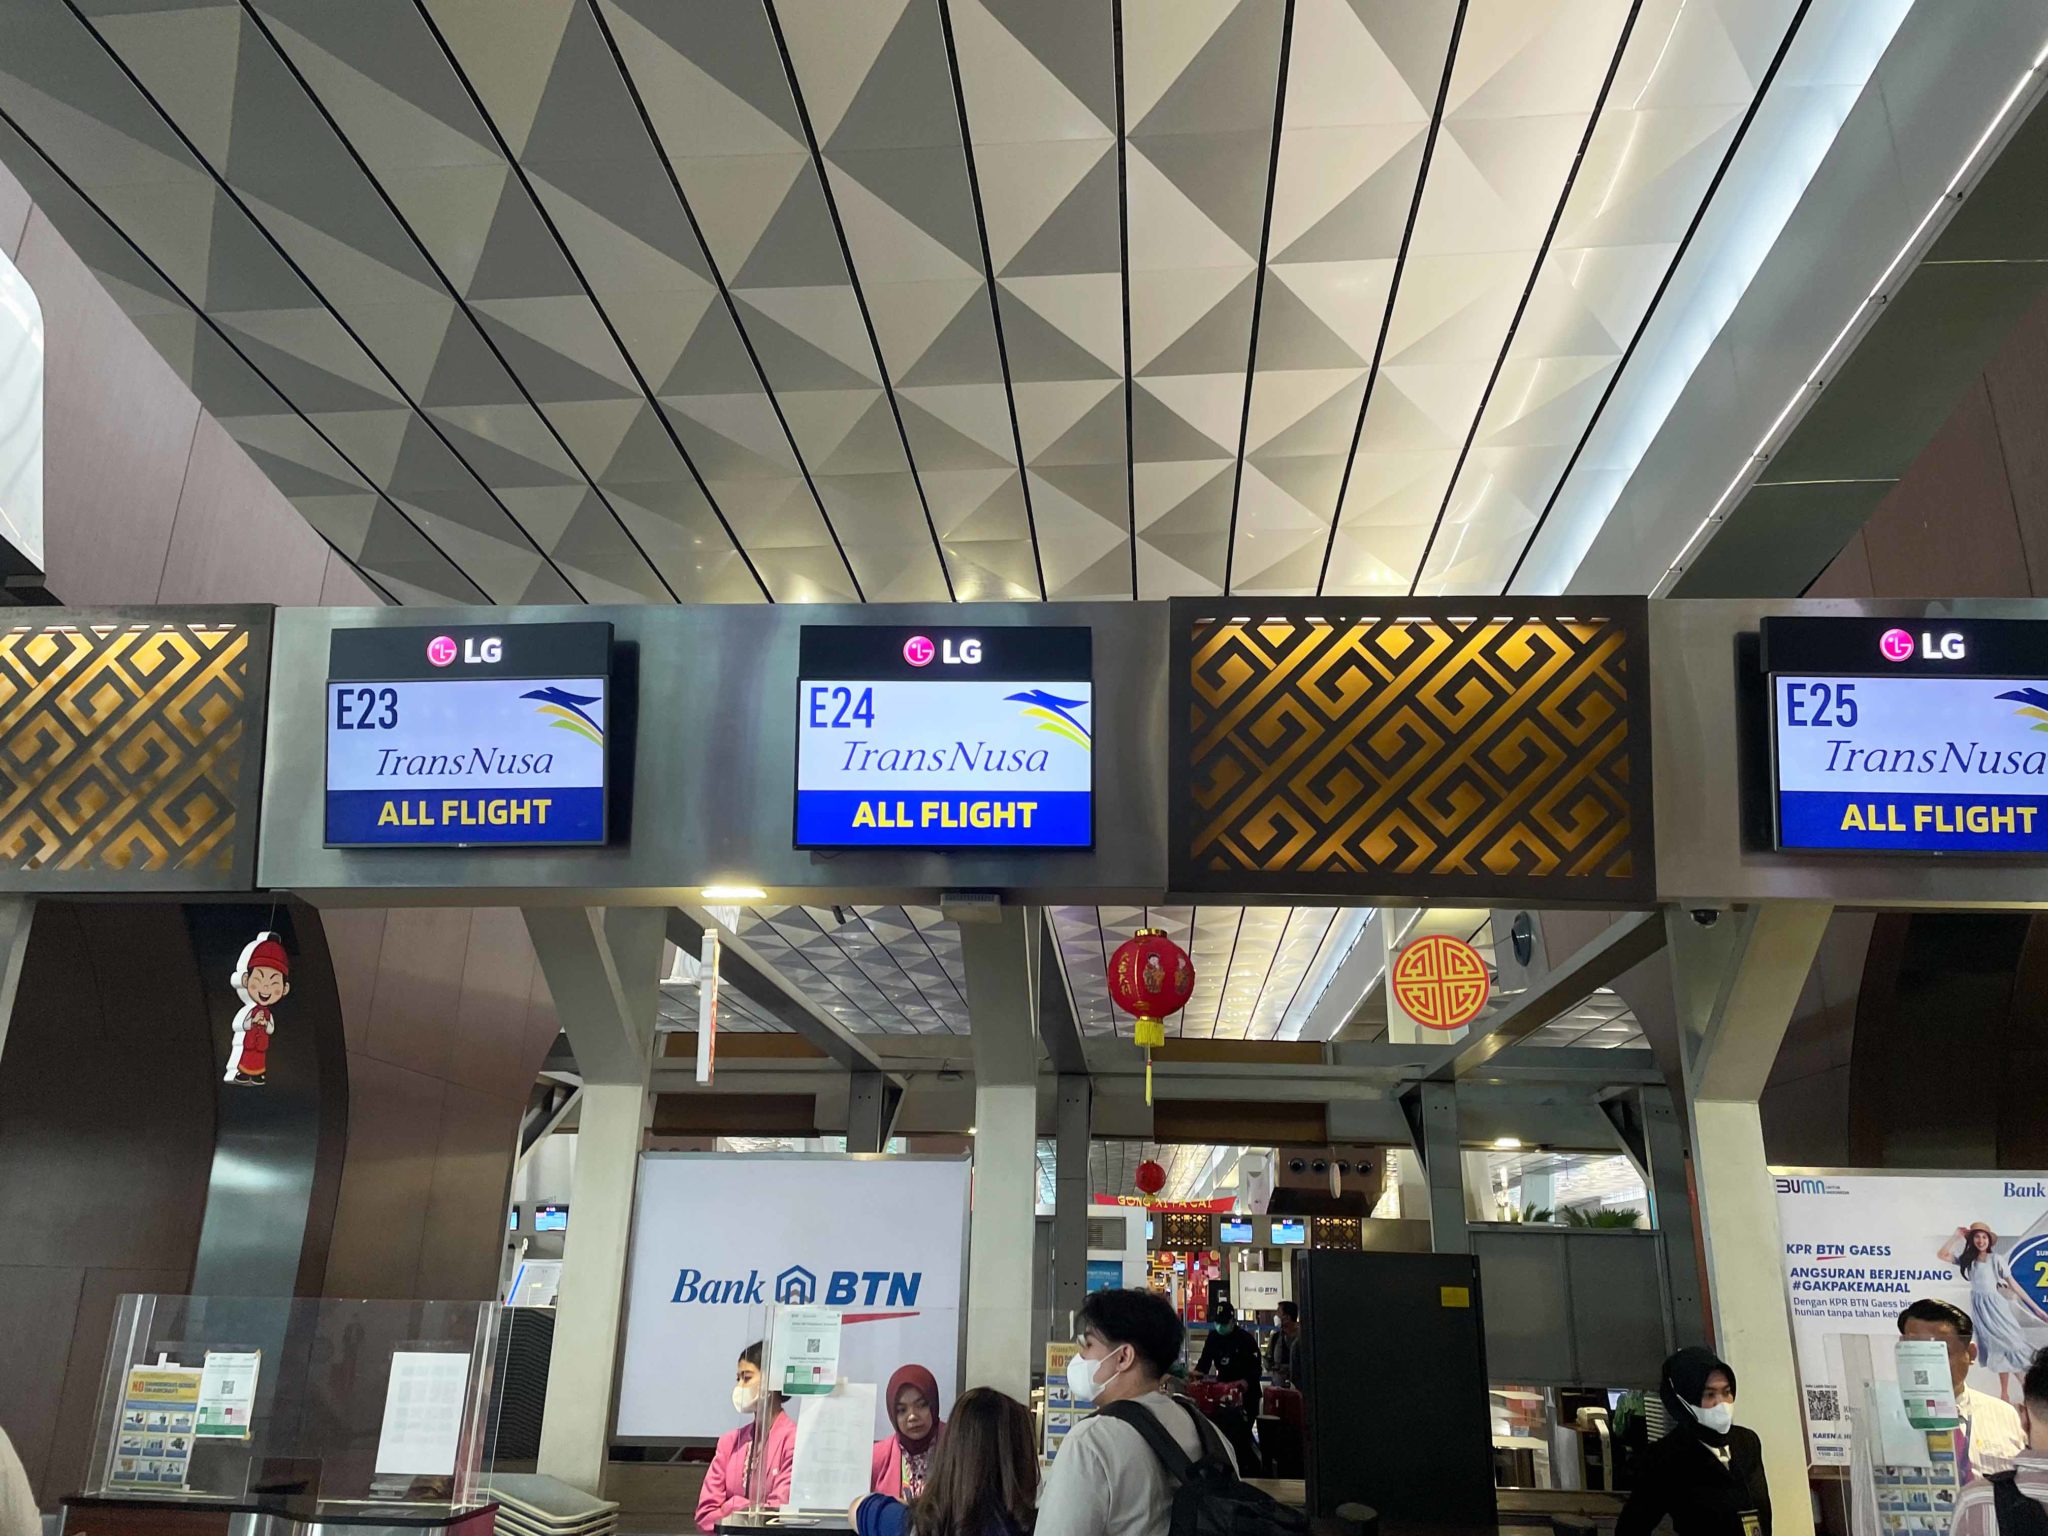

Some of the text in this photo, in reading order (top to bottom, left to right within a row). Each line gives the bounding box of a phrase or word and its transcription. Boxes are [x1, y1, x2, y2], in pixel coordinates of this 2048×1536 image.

[464, 638, 503, 663] LG
[942, 639, 982, 664] LG
[1922, 632, 1965, 660] LG
[336, 688, 399, 730] E23
[809, 687, 875, 728] E24
[1787, 683, 1858, 727] E25
[376, 747, 553, 776] TransNusa
[840, 741, 1049, 772] TransNusa
[1825, 740, 2046, 775] TransNusa
[377, 799, 552, 826] ALL FLIGHT
[852, 801, 1038, 828] ALL FLIGHT
[1840, 804, 2038, 834] ALL FLIGHT
[2003, 1182, 2046, 1198] Bank
[1786, 1243, 1892, 1256] KPR BTN GAESS
[670, 1268, 922, 1307] Bank BTN
[1790, 1267, 1953, 1281] ANGSURAN BERJENJANG
[1792, 1280, 1911, 1294] #GAKPAKEMAHAL
[1793, 1297, 1912, 1309] Dengan KPR BTN Gaess bis
[1794, 1308, 1825, 1317] hunian
[1827, 1309, 1853, 1319] tanpa
[1855, 1309, 1881, 1318] tahan
[1051, 1354, 1064, 1368] NO
